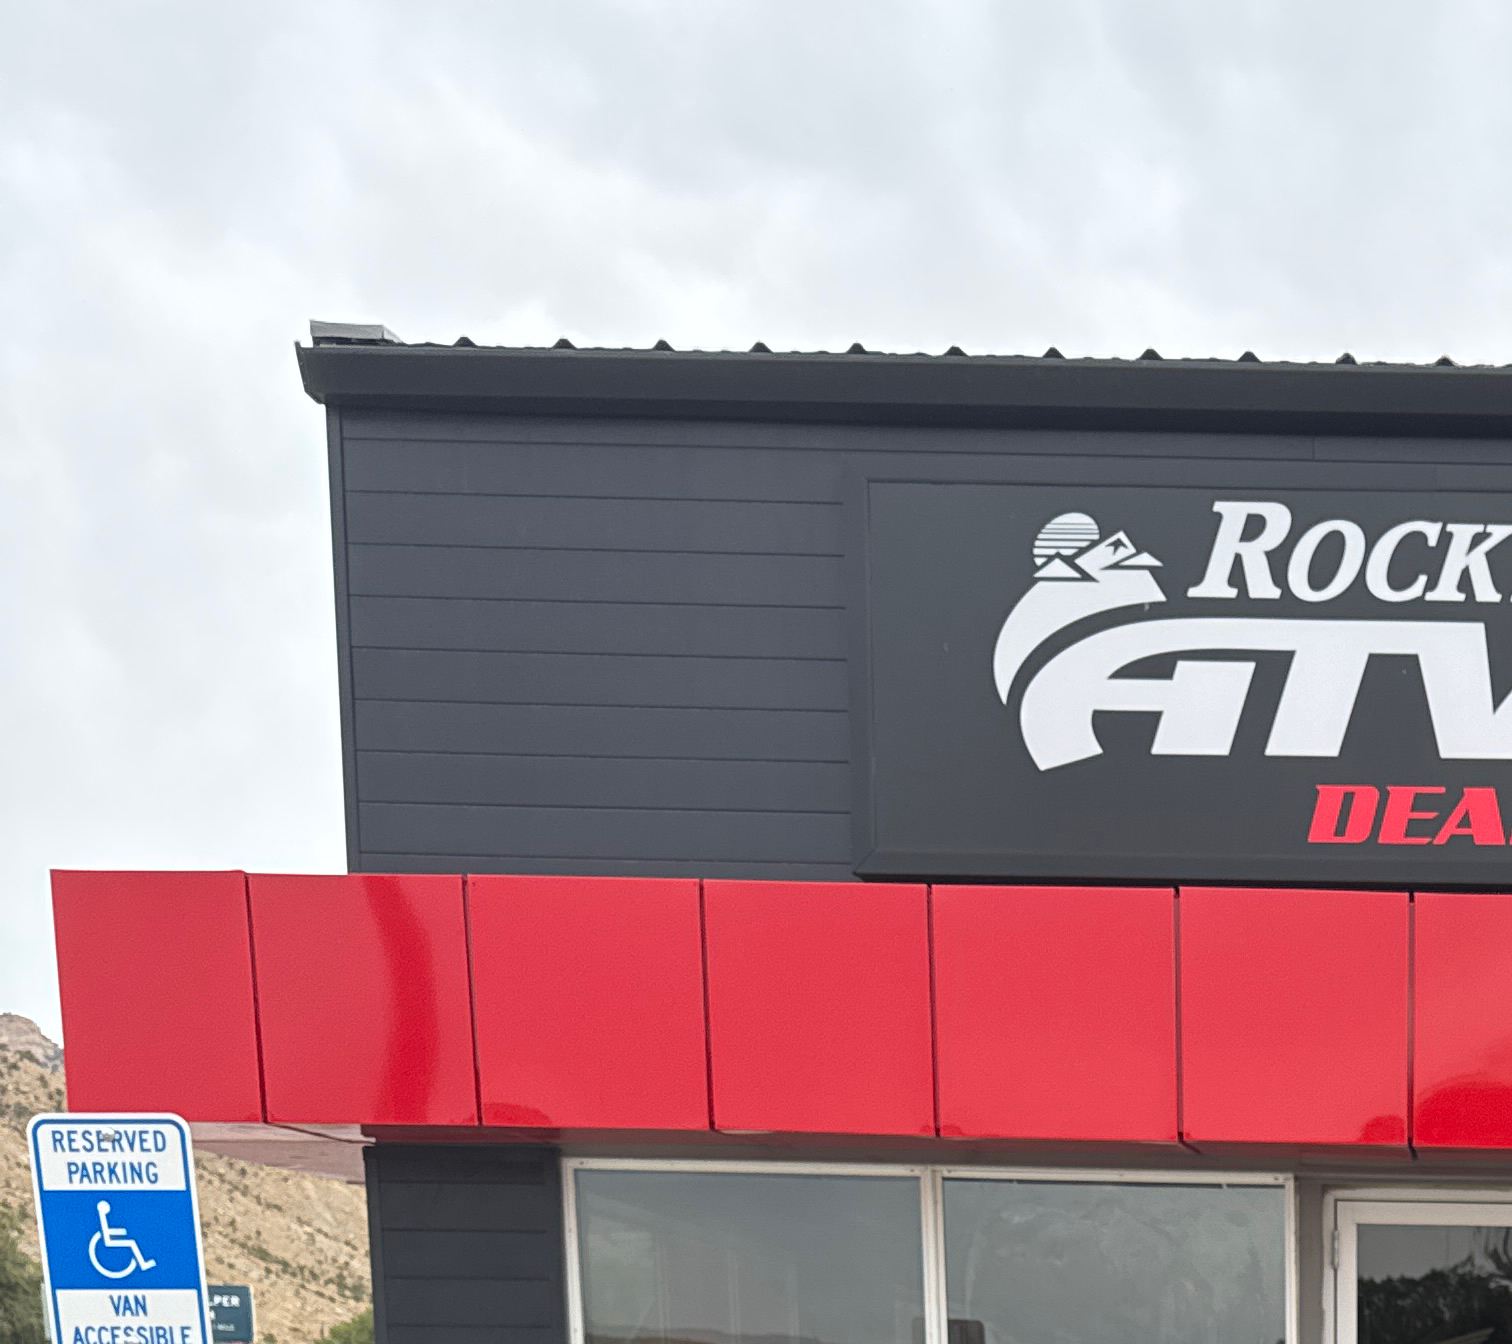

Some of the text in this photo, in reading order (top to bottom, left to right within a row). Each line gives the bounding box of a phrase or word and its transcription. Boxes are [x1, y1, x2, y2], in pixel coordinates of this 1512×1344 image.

[51, 1129, 167, 1153] RESERVED
[67, 1161, 159, 1185] PARKING
[109, 1295, 149, 1317] VAN
